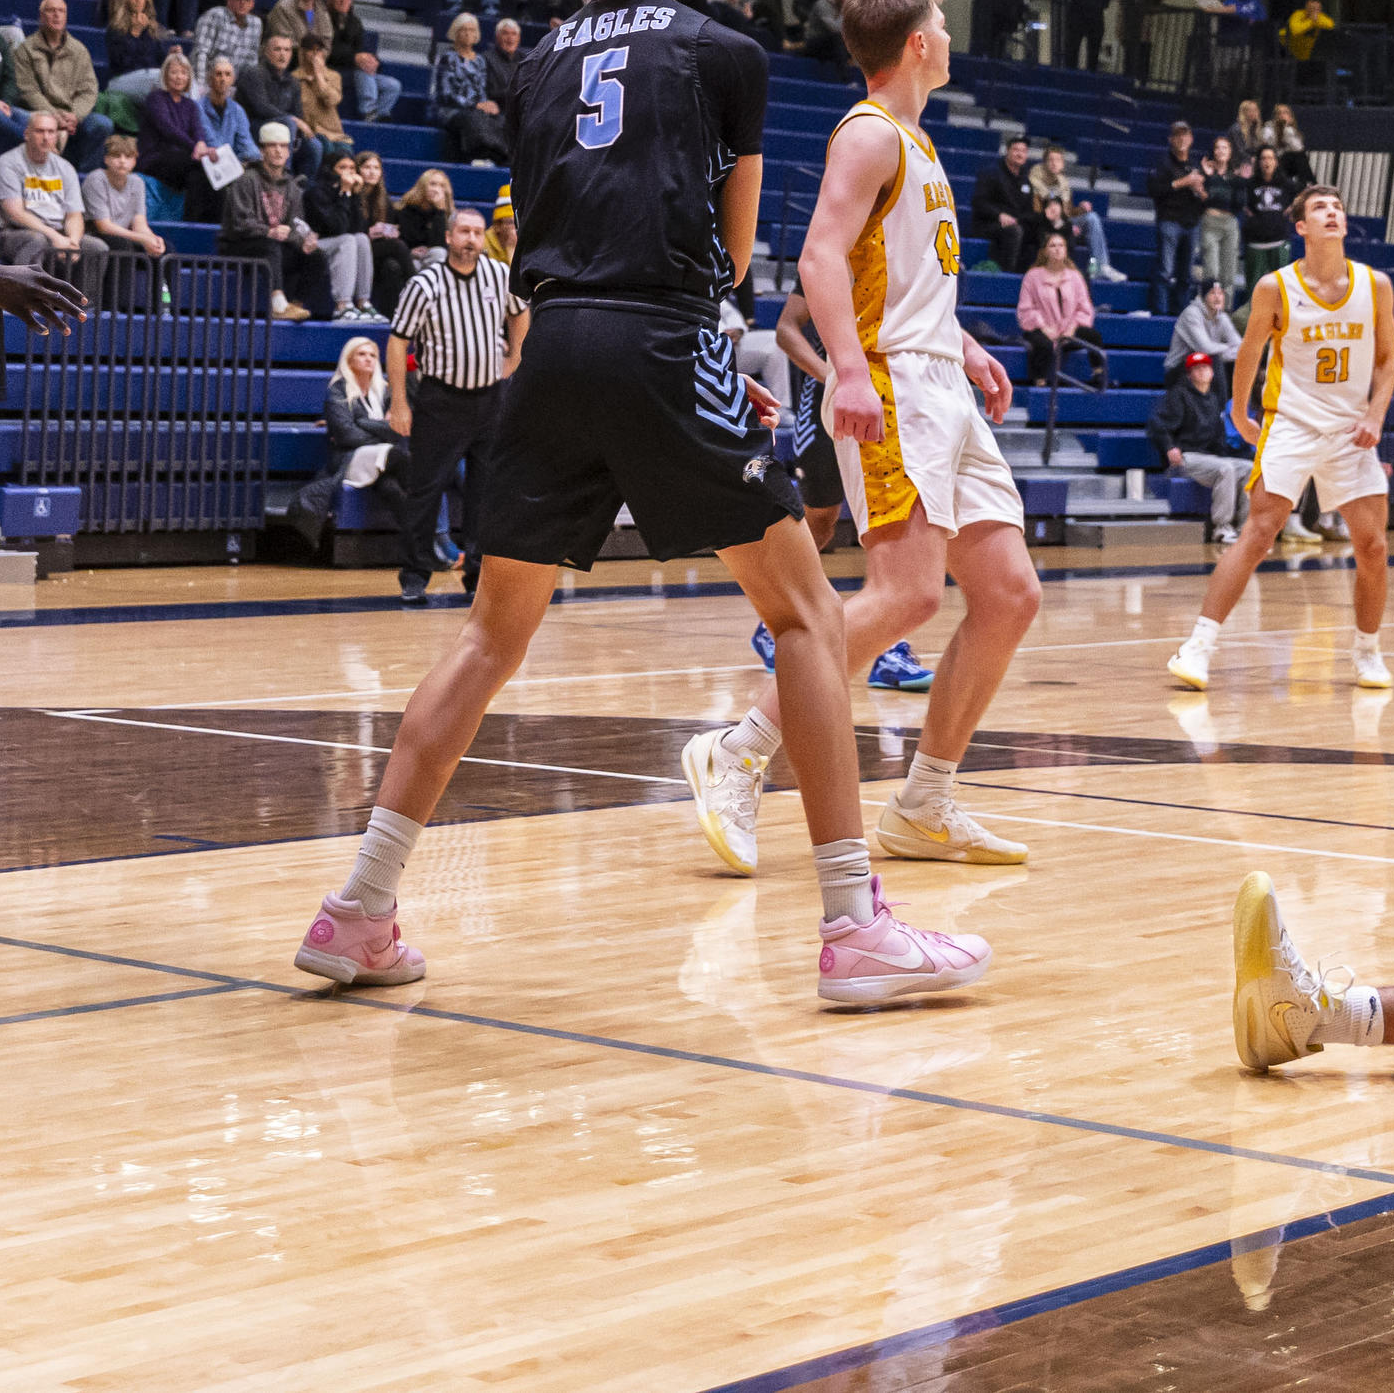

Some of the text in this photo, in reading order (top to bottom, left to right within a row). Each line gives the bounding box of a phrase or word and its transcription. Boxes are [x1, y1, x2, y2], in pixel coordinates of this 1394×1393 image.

[553, 6, 677, 52] EAGLES
[575, 45, 630, 149] 5
[1301, 322, 1364, 343] EAGLES
[1316, 347, 1350, 383] 21
